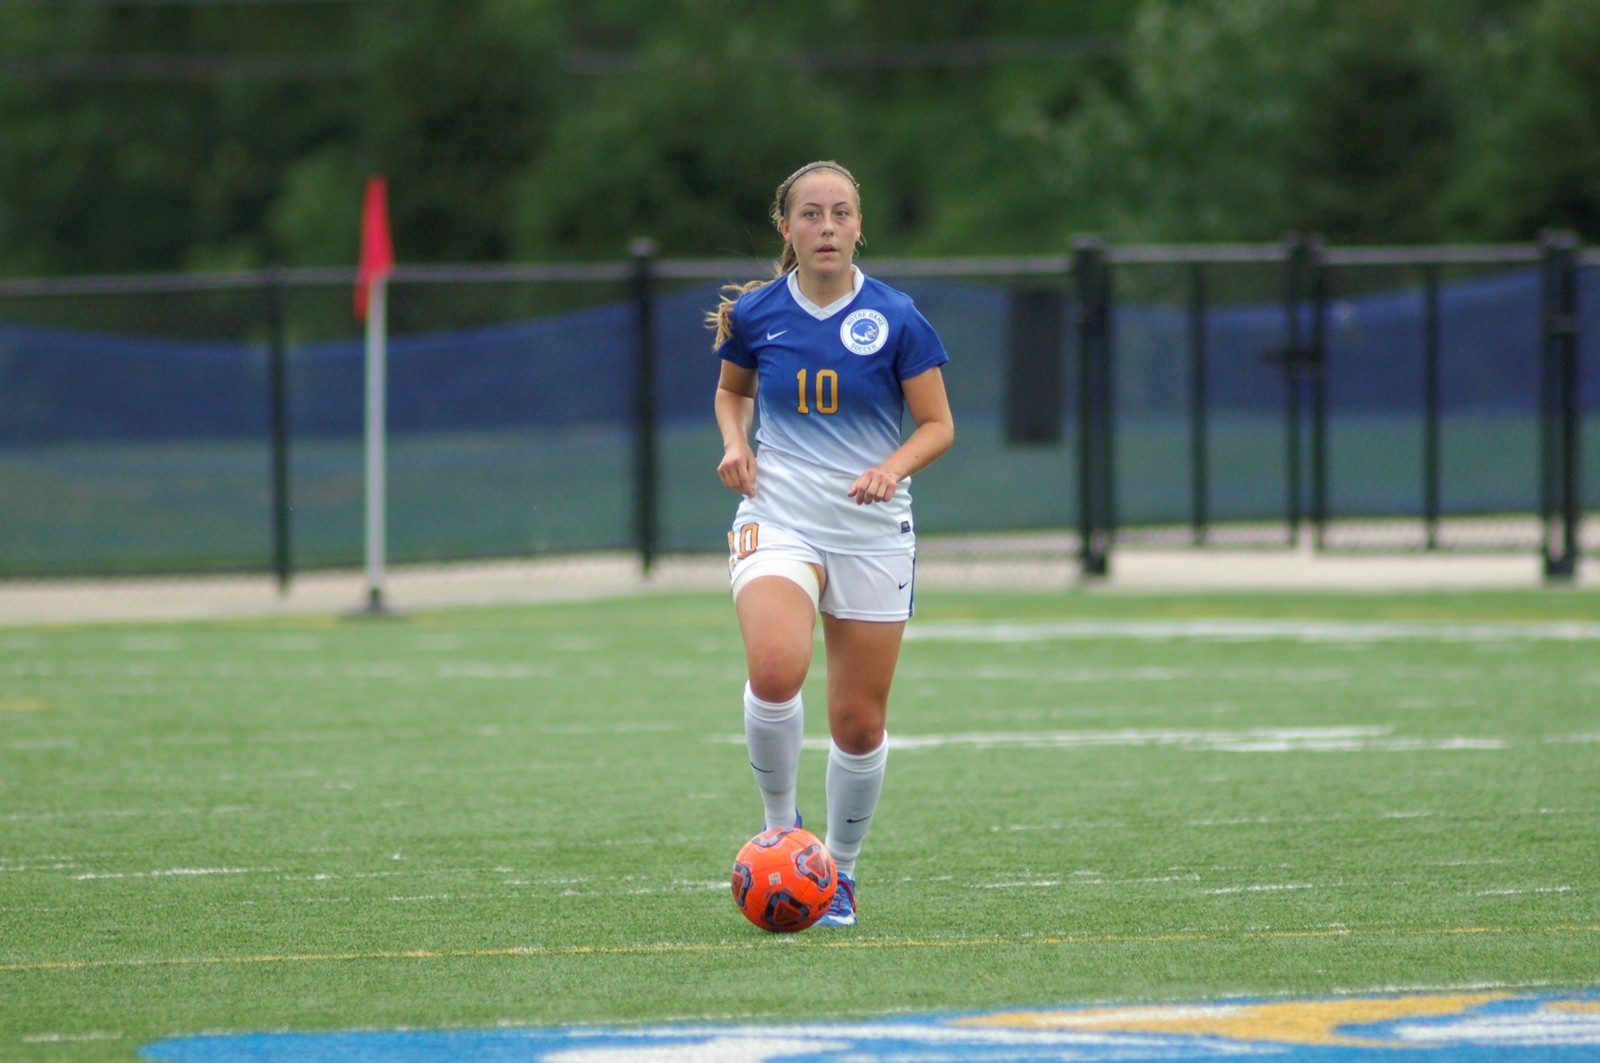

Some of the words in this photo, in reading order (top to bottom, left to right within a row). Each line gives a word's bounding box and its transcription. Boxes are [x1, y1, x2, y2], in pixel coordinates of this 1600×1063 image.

[846, 311, 866, 326] NOTRE
[868, 312, 885, 326] DAME
[850, 342, 877, 353] SOCCER
[796, 368, 839, 415] 10
